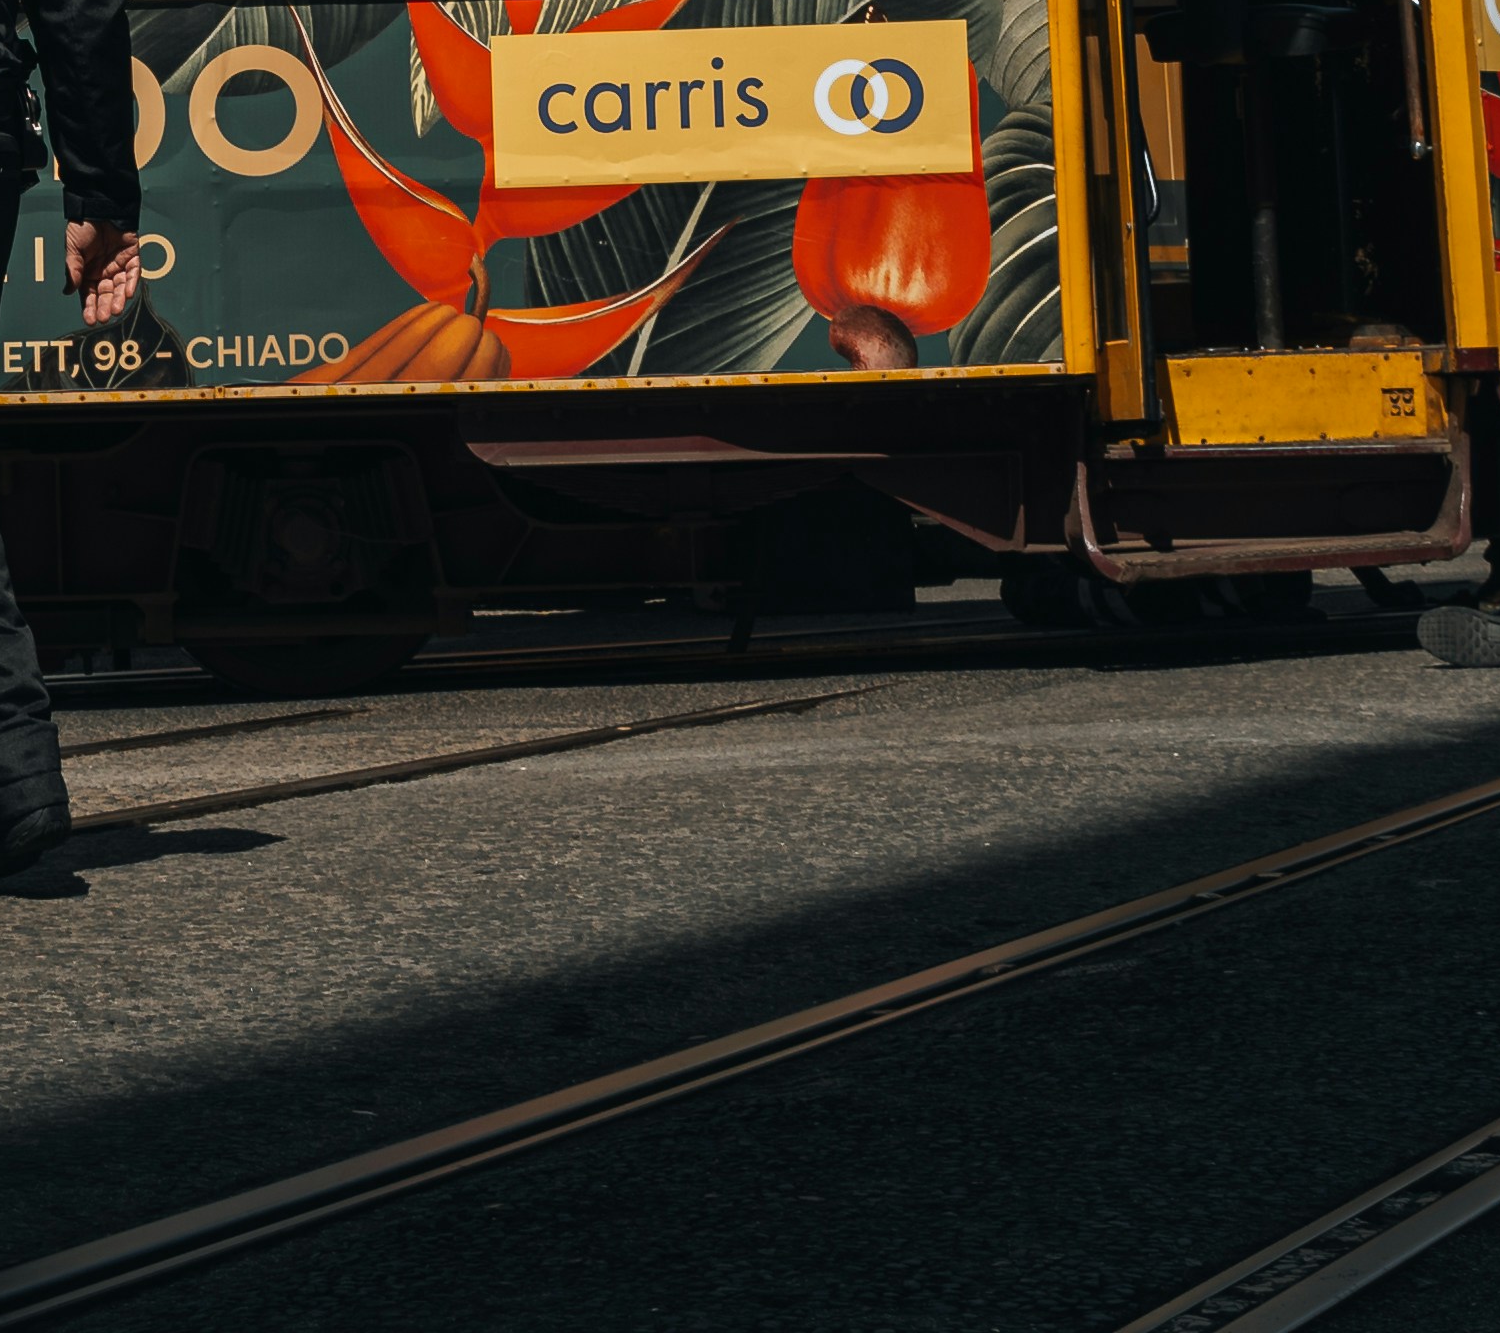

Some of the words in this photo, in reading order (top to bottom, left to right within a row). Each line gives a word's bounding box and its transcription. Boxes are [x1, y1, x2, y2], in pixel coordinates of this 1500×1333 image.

[537, 56, 769, 135] carris
[94, 340, 142, 372] 98
[186, 332, 350, 369] CHIADO
